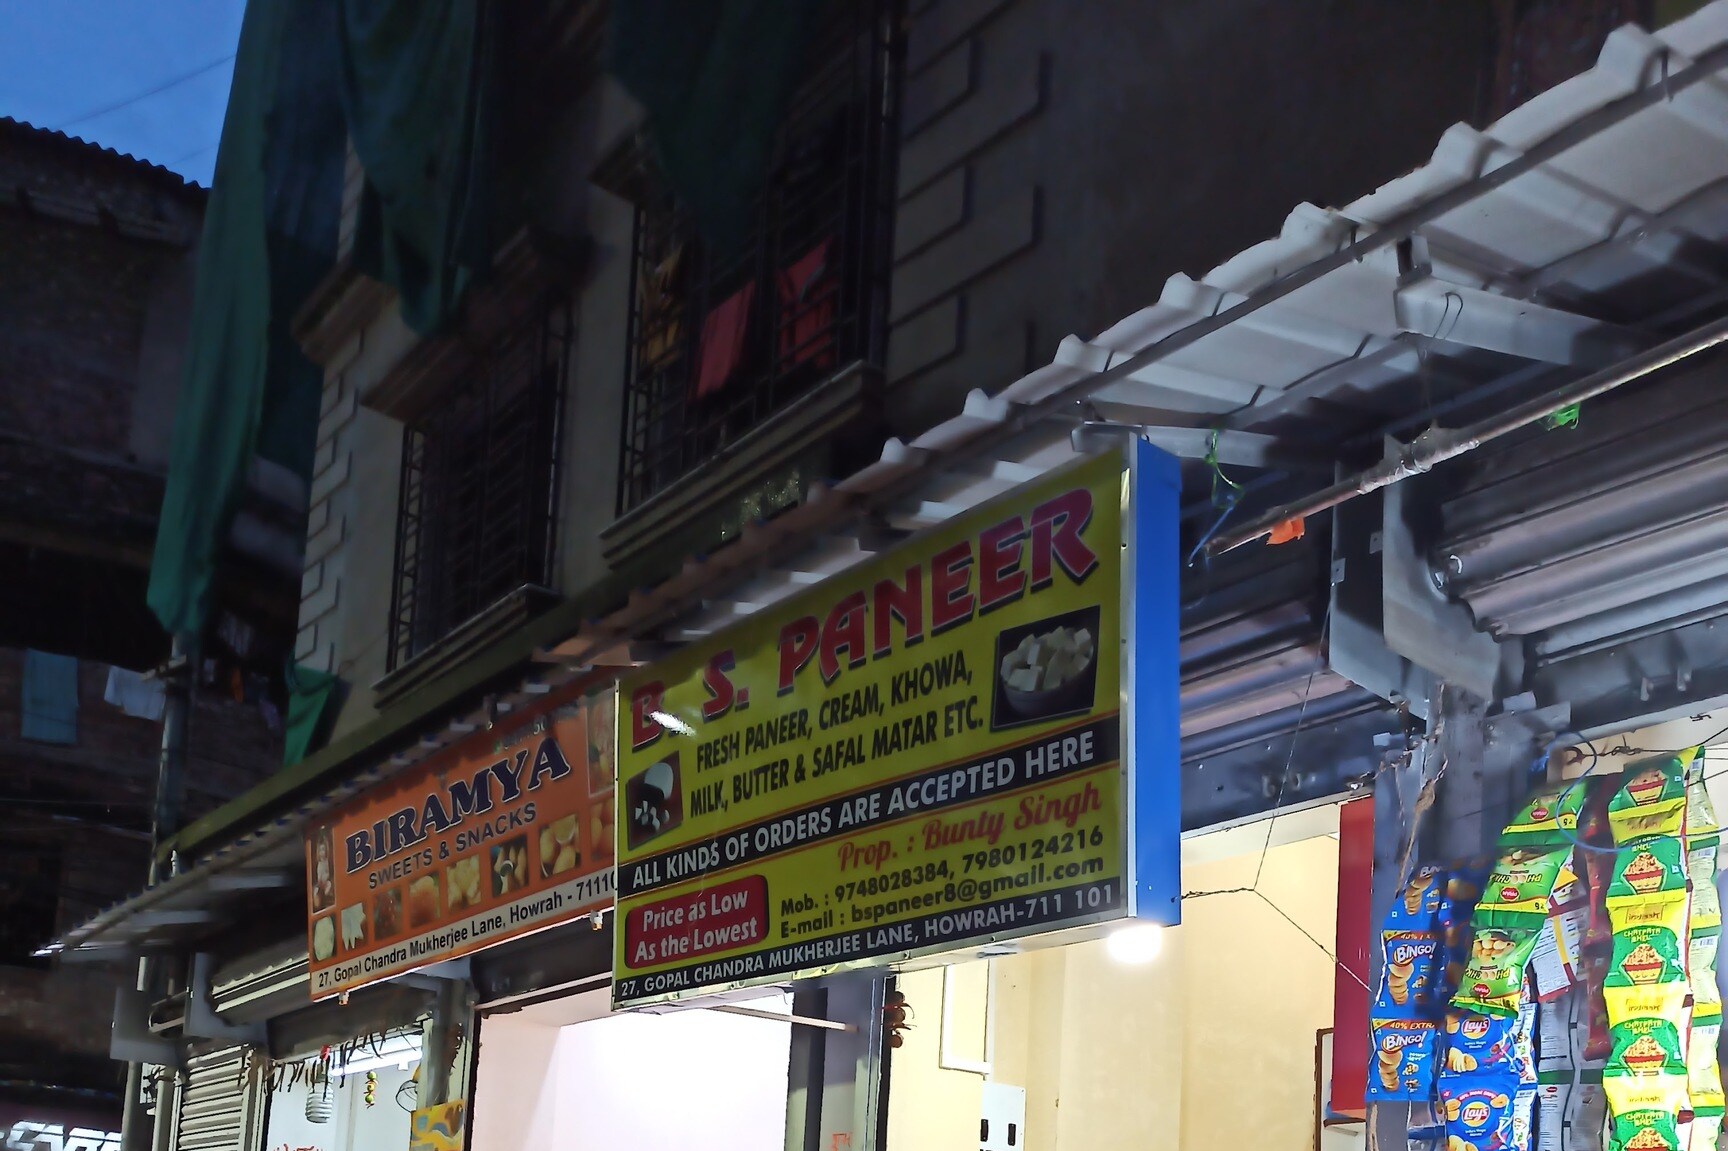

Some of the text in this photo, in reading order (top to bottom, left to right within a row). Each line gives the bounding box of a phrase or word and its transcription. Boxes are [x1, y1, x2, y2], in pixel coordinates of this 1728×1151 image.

[632, 488, 1099, 754] B S. PANEER
[690, 695, 983, 818] MILK, BUTTER & SAFAL MATAR ETC.
[697, 650, 972, 773] FRESH PANEER, CREAM, KHOWA,
[345, 737, 571, 875] BIRAMYA
[368, 801, 538, 890] SWEETS & SNACKS
[632, 730, 1094, 889] ALL KINDS OF ORDERS ARE ACCEPTED HERE
[837, 840, 898, 873] Prop.
[922, 810, 1006, 851] Bunty
[1013, 781, 1102, 830] Singh
[643, 890, 749, 932] Price as Low
[780, 909, 833, 939] E-mail
[851, 856, 1104, 923] bspaneer8@gmail.com
[781, 893, 818, 917] Mob.
[834, 859, 955, 903] 9748028384,
[962, 825, 1103, 874] 7980124216
[318, 971, 332, 988] 27,
[334, 960, 362, 983] Gopal
[364, 946, 407, 972] Chandra
[409, 928, 468, 957] Mukherjee
[471, 918, 506, 943] Lane,
[510, 891, 562, 924] Howrah
[621, 884, 1112, 998] 27, GOPAL CHANDRA MUKHERJEE LANE, HOWRAH-711 101
[634, 916, 758, 963] As the Lowest
[1386, 1030, 1428, 1052] BINGO!
